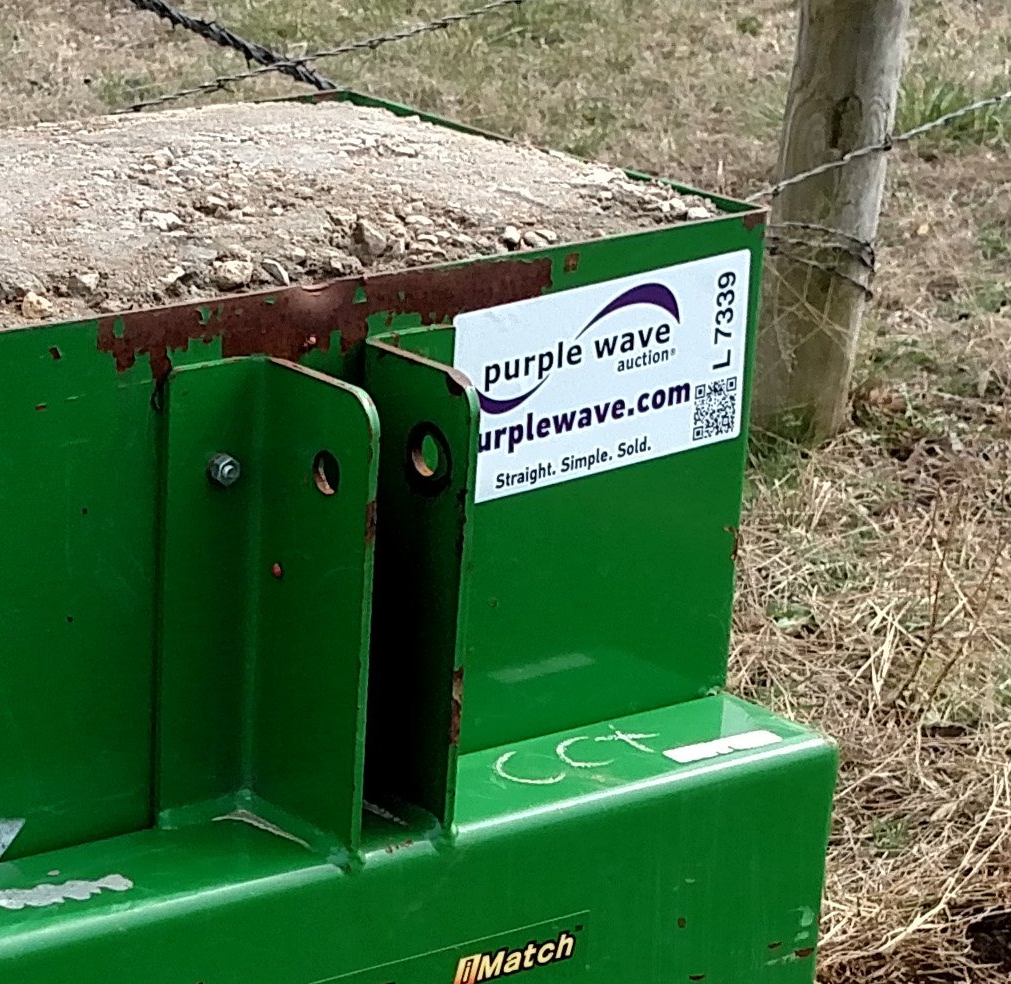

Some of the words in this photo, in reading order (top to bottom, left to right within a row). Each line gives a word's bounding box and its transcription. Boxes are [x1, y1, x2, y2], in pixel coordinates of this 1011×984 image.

[714, 271, 737, 345] 7339
[484, 341, 583, 392] purple
[594, 323, 671, 360] wave
[712, 349, 731, 370] L
[477, 382, 691, 454] urplewave.com
[495, 463, 556, 488] Straight.
[561, 449, 613, 473] Simple.
[617, 436, 652, 458] Sold.
